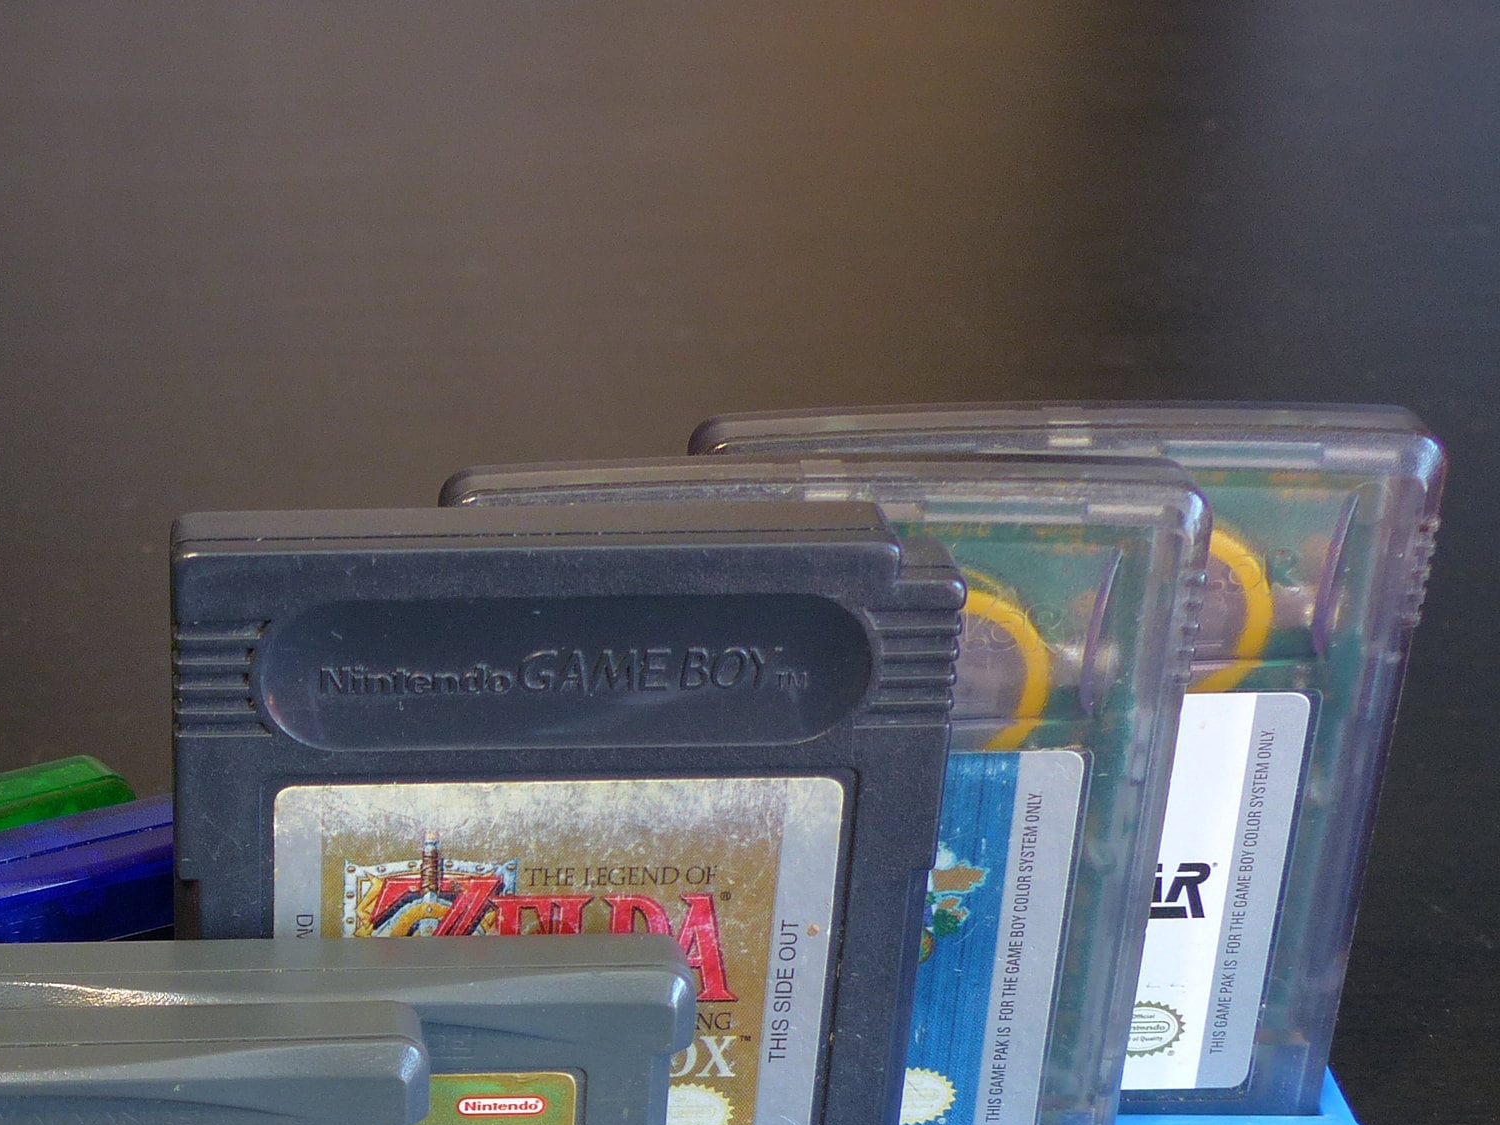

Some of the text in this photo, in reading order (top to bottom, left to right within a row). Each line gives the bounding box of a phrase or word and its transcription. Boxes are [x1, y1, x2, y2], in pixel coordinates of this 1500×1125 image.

[319, 664, 514, 695] Nintendo
[517, 646, 672, 694] GAME
[679, 645, 784, 690] BOY
[1019, 825, 1038, 872] SYSTEM
[524, 864, 718, 887] THE LEGEND OF
[1013, 875, 1032, 913] COLOR
[1209, 728, 1275, 1055] THIS GAME PAK IS FOR THE GAME BOY COLOR SYSTEM ONLY.
[1010, 915, 1027, 938] BOY
[1005, 940, 1023, 974] GAME
[768, 919, 799, 1063] THIS SIDE OUT
[1001, 976, 1018, 998] THE
[998, 1000, 1015, 1021] FOR
[996, 1026, 1012, 1037] IS
[993, 1040, 1010, 1061] PAK
[989, 1063, 1007, 1096] GAME
[464, 1100, 539, 1112] Nintendo
[985, 1097, 1002, 1123] THIS
